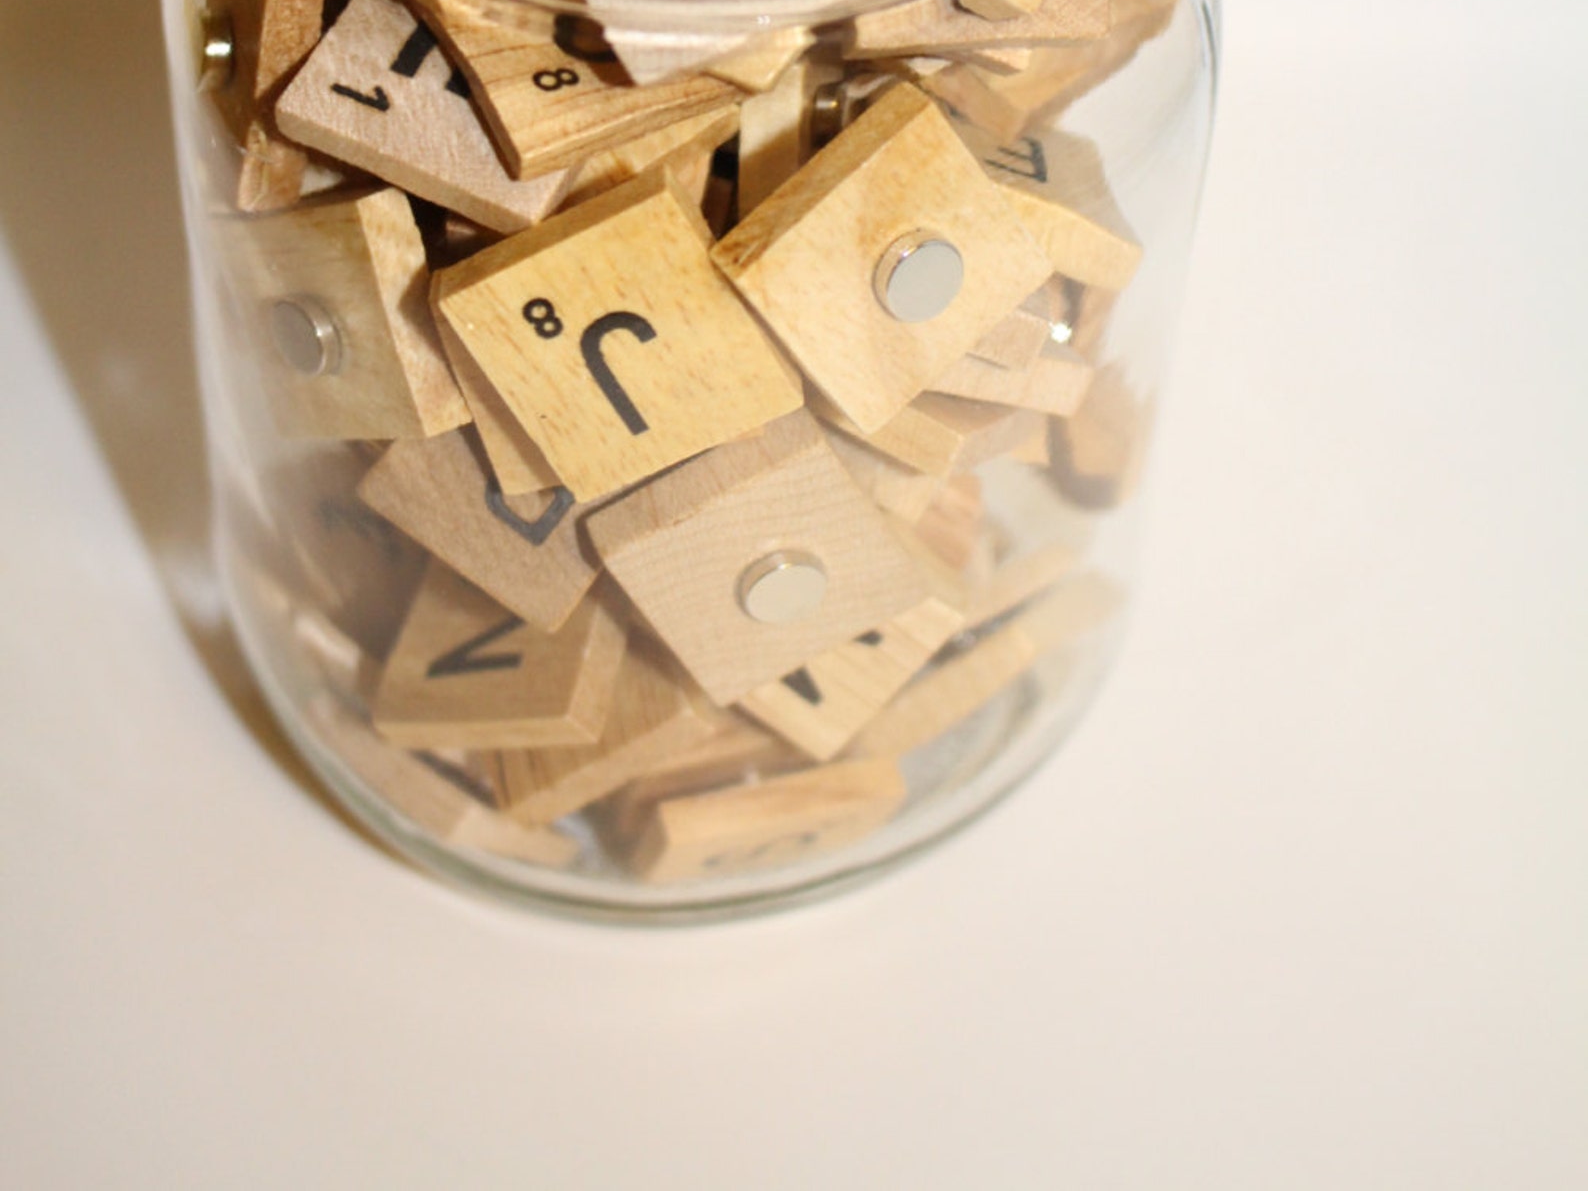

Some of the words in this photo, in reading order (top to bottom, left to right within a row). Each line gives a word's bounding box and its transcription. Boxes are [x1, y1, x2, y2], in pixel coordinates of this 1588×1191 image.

[532, 67, 580, 92] 8
[522, 297, 564, 340] 8
[580, 310, 657, 436] J
